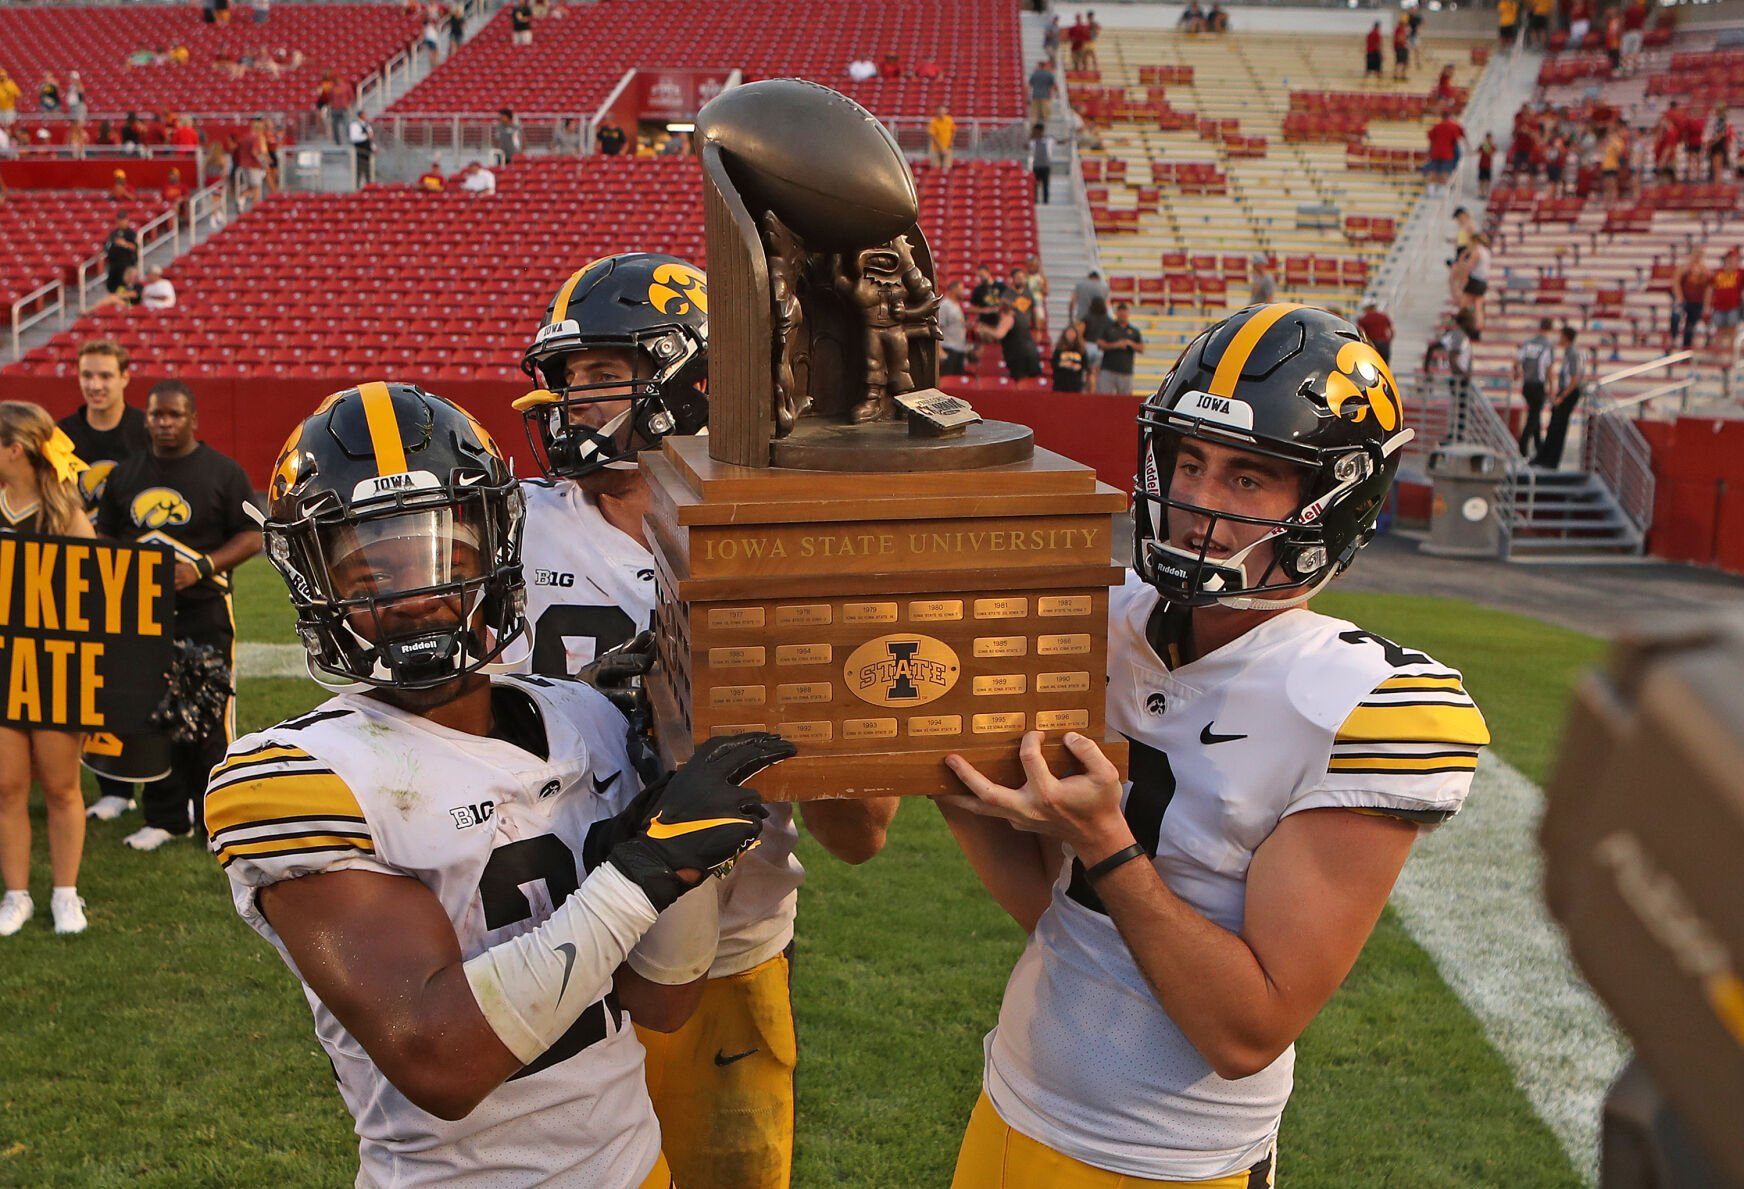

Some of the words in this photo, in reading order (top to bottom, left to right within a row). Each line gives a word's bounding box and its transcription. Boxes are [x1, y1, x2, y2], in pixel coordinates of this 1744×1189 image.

[543, 322, 563, 337] IOWA
[1196, 395, 1231, 415] IOWA
[373, 474, 416, 492] IOWA
[705, 537, 788, 561] IOWA
[801, 534, 895, 558] STATE
[909, 527, 1099, 555] UNIVERSITY
[1158, 563, 1188, 579] Riddell
[401, 640, 437, 654] Riddell
[0, 635, 104, 726] ATE
[860, 659, 946, 689] STATE
